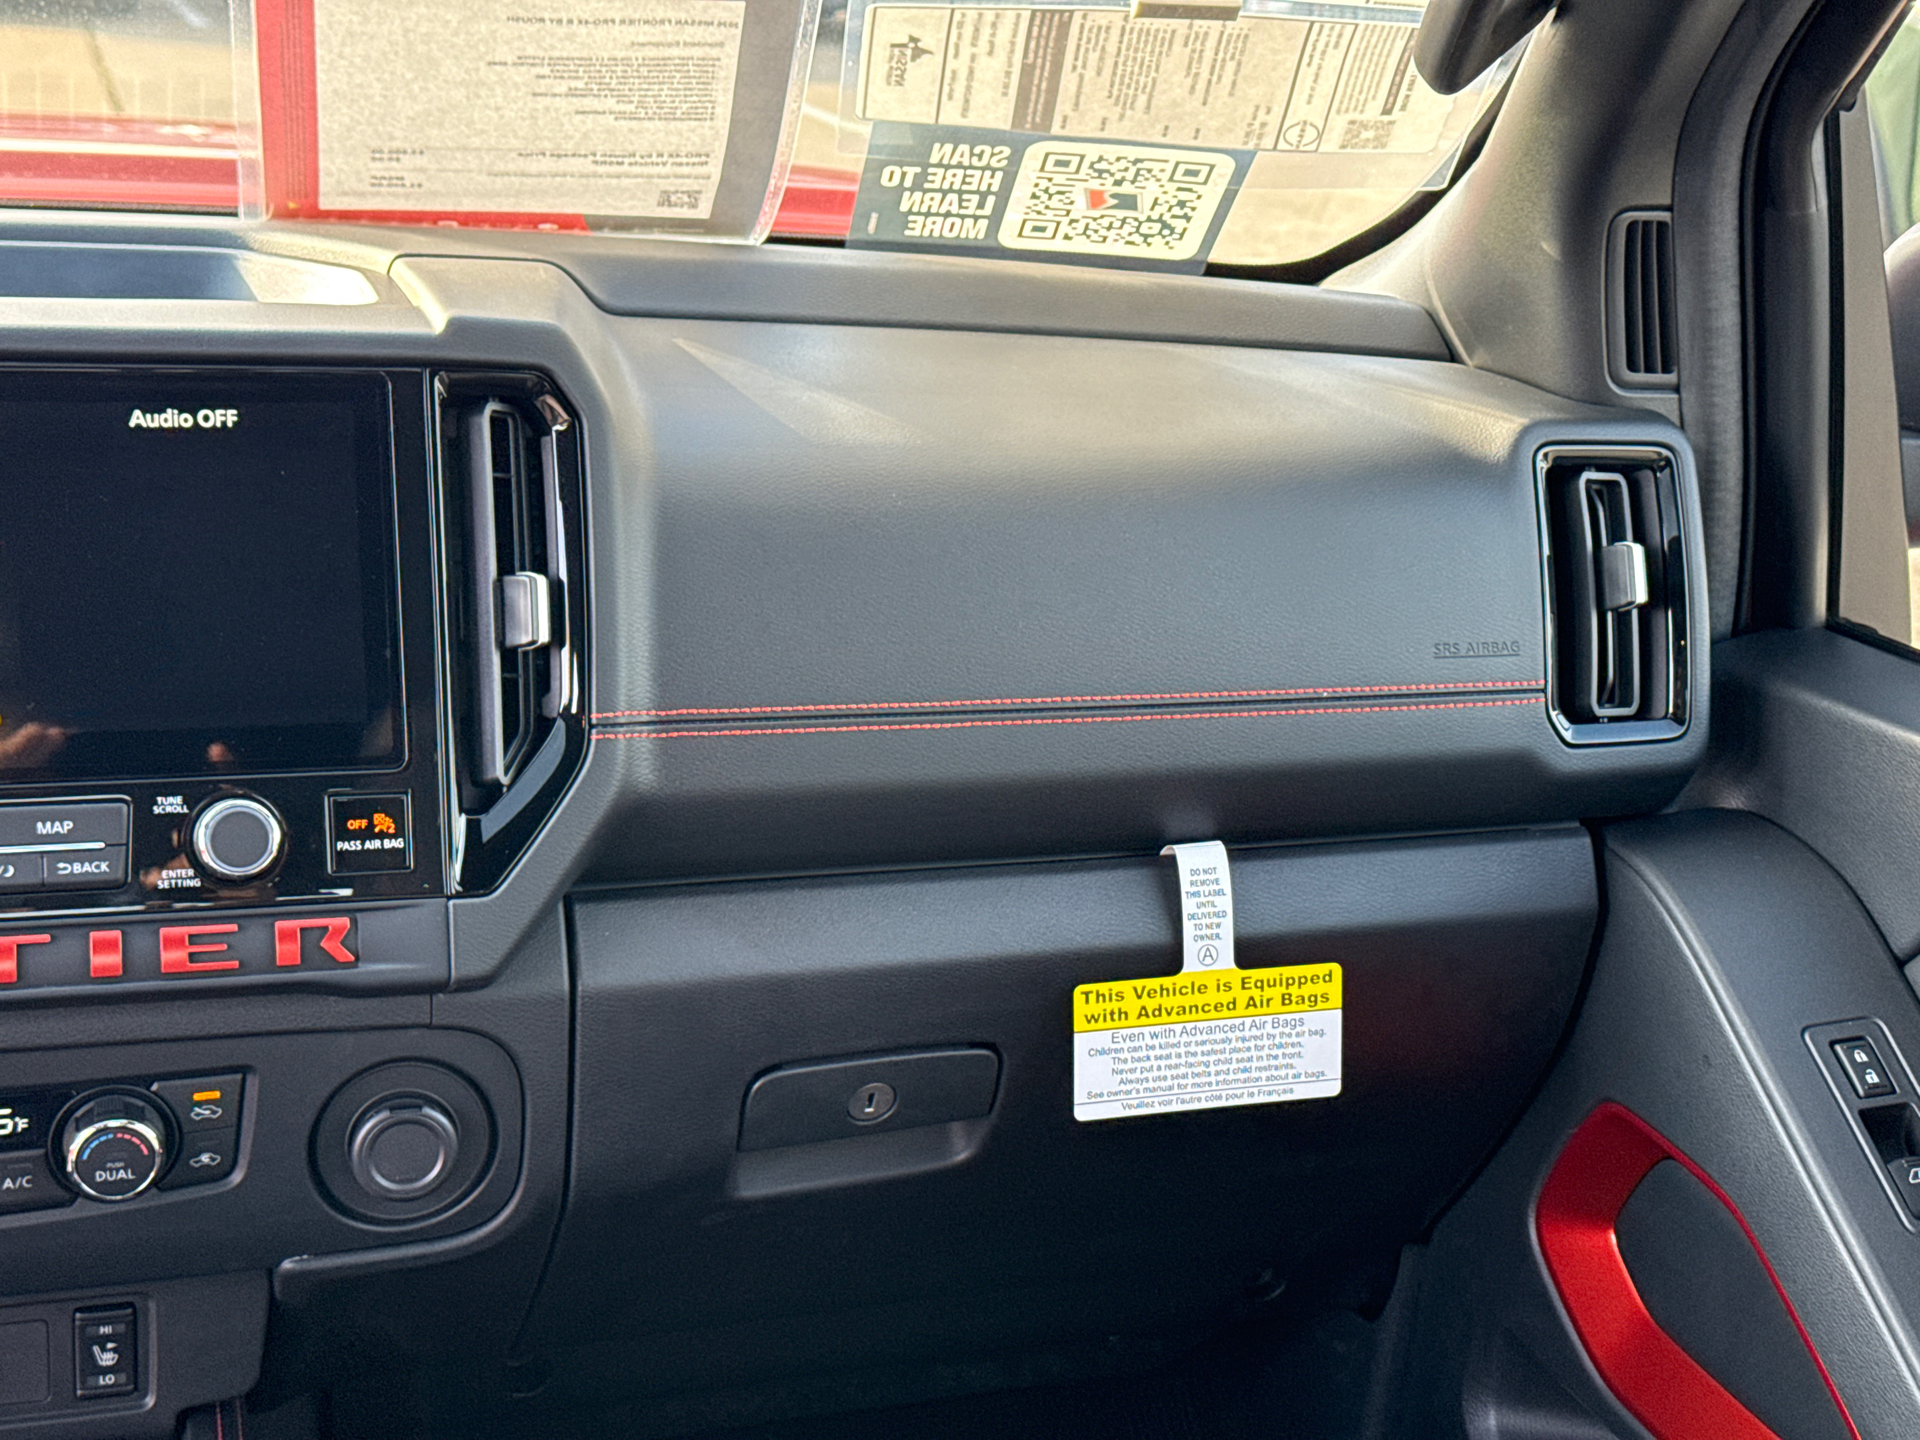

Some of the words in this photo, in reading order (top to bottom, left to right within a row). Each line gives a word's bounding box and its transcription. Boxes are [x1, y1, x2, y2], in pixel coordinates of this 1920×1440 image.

[128, 408, 194, 428] Audio
[196, 409, 239, 428] OFF
[1433, 642, 1460, 655] SRS
[1465, 640, 1521, 655] AIRBAG
[156, 796, 183, 805] TUNE
[153, 805, 189, 814] SCROLL
[36, 820, 74, 835] MAP
[347, 819, 369, 830] OFF
[336, 840, 362, 851] PASS
[364, 839, 382, 850] AIR
[383, 838, 404, 849] BAG
[73, 861, 110, 874] BACK
[161, 869, 195, 879] ENTER
[1190, 868, 1200, 877] DO
[1202, 867, 1217, 876] NOT
[157, 878, 201, 889] SETTING
[1190, 878, 1220, 888] REMOVE
[1185, 890, 1201, 900] THIS
[1203, 889, 1227, 898] LABEL
[1196, 900, 1217, 909] UNTIL
[1187, 910, 1227, 921] DELIVERED
[1193, 922, 1203, 931] TO
[1205, 922, 1222, 930] NEW
[1193, 932, 1222, 942] OWNER.
[1201, 946, 1215, 962] A
[1080, 988, 1125, 1005] This
[1132, 981, 1208, 1000] Vehicle
[1216, 978, 1233, 993] is
[1240, 969, 1333, 992] Equipped
[1084, 1007, 1128, 1024] with
[1136, 997, 1237, 1020] Advanced
[1244, 995, 1274, 1010] Air
[1281, 992, 1330, 1008] Bags
[1111, 1031, 1145, 1044] Even
[1149, 1027, 1176, 1040] with
[1179, 1020, 1245, 1038] Advanced
[1248, 1018, 1268, 1031] Air
[1271, 1017, 1305, 1030] Bags
[1088, 1047, 1124, 1057] Children
[1127, 1045, 1143, 1054] can
[1145, 1042, 1156, 1051] be
[1158, 1039, 1181, 1050] killed
[1183, 1040, 1192, 1048] or
[1194, 1035, 1233, 1047] seriously
[1235, 1032, 1263, 1044] injured
[1266, 1032, 1276, 1041] by
[1279, 1030, 1293, 1038] the
[1294, 1029, 1306, 1038] air
[1308, 1027, 1326, 1038] bag.
[1111, 1057, 1128, 1066] The
[1131, 1054, 1151, 1064] back
[1154, 1052, 1172, 1061] seat
[1175, 1051, 1182, 1059] is
[1184, 1049, 1198, 1058] the
[1201, 1045, 1226, 1057] safest
[1229, 1044, 1252, 1055] place
[1254, 1043, 1266, 1051] for
[1268, 1040, 1304, 1051] children.
[1111, 1066, 1138, 1076] Never
[1140, 1064, 1154, 1074] put
[1164, 1059, 1210, 1071] rear-facing
[1213, 1056, 1233, 1066] child
[1235, 1054, 1254, 1064] seat
[1256, 1054, 1264, 1062] in
[1266, 1052, 1280, 1061] the
[1282, 1050, 1304, 1059] front.
[1118, 1075, 1149, 1086] Always
[1152, 1074, 1168, 1082] use
[1170, 1071, 1189, 1080] seat
[1191, 1068, 1211, 1078] belts
[1214, 1067, 1230, 1077] and
[1232, 1065, 1252, 1075] child
[1255, 1062, 1296, 1072] restraints.
[1087, 1090, 1104, 1100] See
[1106, 1086, 1140, 1098] owner's
[1143, 1083, 1175, 1094] manual
[1177, 1081, 1189, 1090] for
[1191, 1080, 1213, 1089] more
[1215, 1074, 1263, 1087] information
[1265, 1072, 1289, 1082] about
[1291, 1071, 1302, 1079] air
[1304, 1069, 1327, 1079] bags.
[1121, 1098, 1155, 1110] Veuillez
[1157, 1097, 1174, 1106] voir
[1175, 1095, 1202, 1105] l'autre
[1204, 1093, 1223, 1103] côté
[1225, 1090, 1244, 1101] pour
[1247, 1090, 1255, 1098] le
[1257, 1086, 1294, 1097] Français
[95, 1168, 136, 1182] DUAL
[2, 1175, 33, 1190] A/C
[99, 1324, 113, 1335] HI
[99, 1373, 115, 1385] LO
